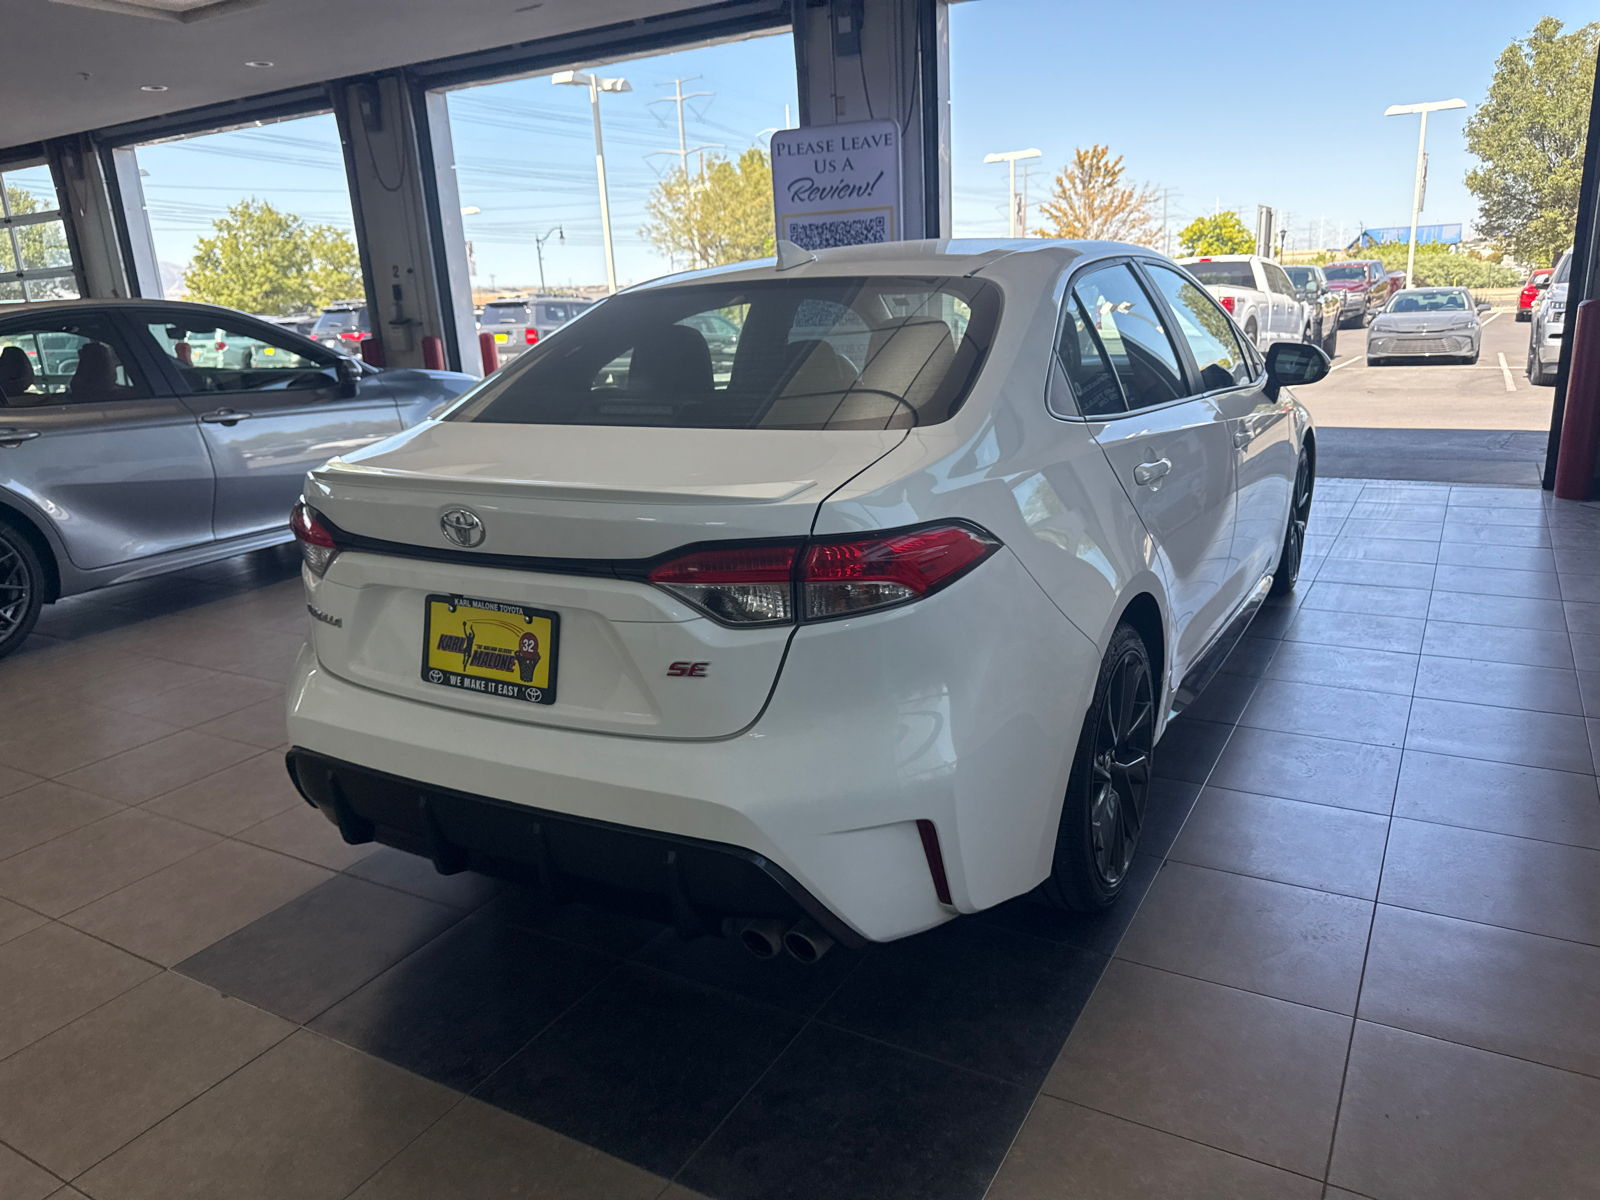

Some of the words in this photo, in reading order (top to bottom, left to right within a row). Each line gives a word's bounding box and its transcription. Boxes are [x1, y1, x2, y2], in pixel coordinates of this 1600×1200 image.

[777, 139, 834, 157] PLEASE
[841, 132, 893, 151] LEAVE
[814, 159, 836, 174] US
[842, 157, 854, 172] A
[787, 170, 884, 203] Review!
[454, 598, 471, 607] KARL
[472, 600, 499, 611] MALONE
[500, 604, 523, 615] TOYOTA
[437, 633, 466, 654] KARL
[522, 639, 535, 652] 32
[470, 649, 516, 673] MALONE
[667, 661, 710, 677] SE
[450, 674, 461, 686] WE
[463, 677, 485, 691] MAKE
[488, 681, 496, 692] IT
[498, 683, 518, 697] EASY
